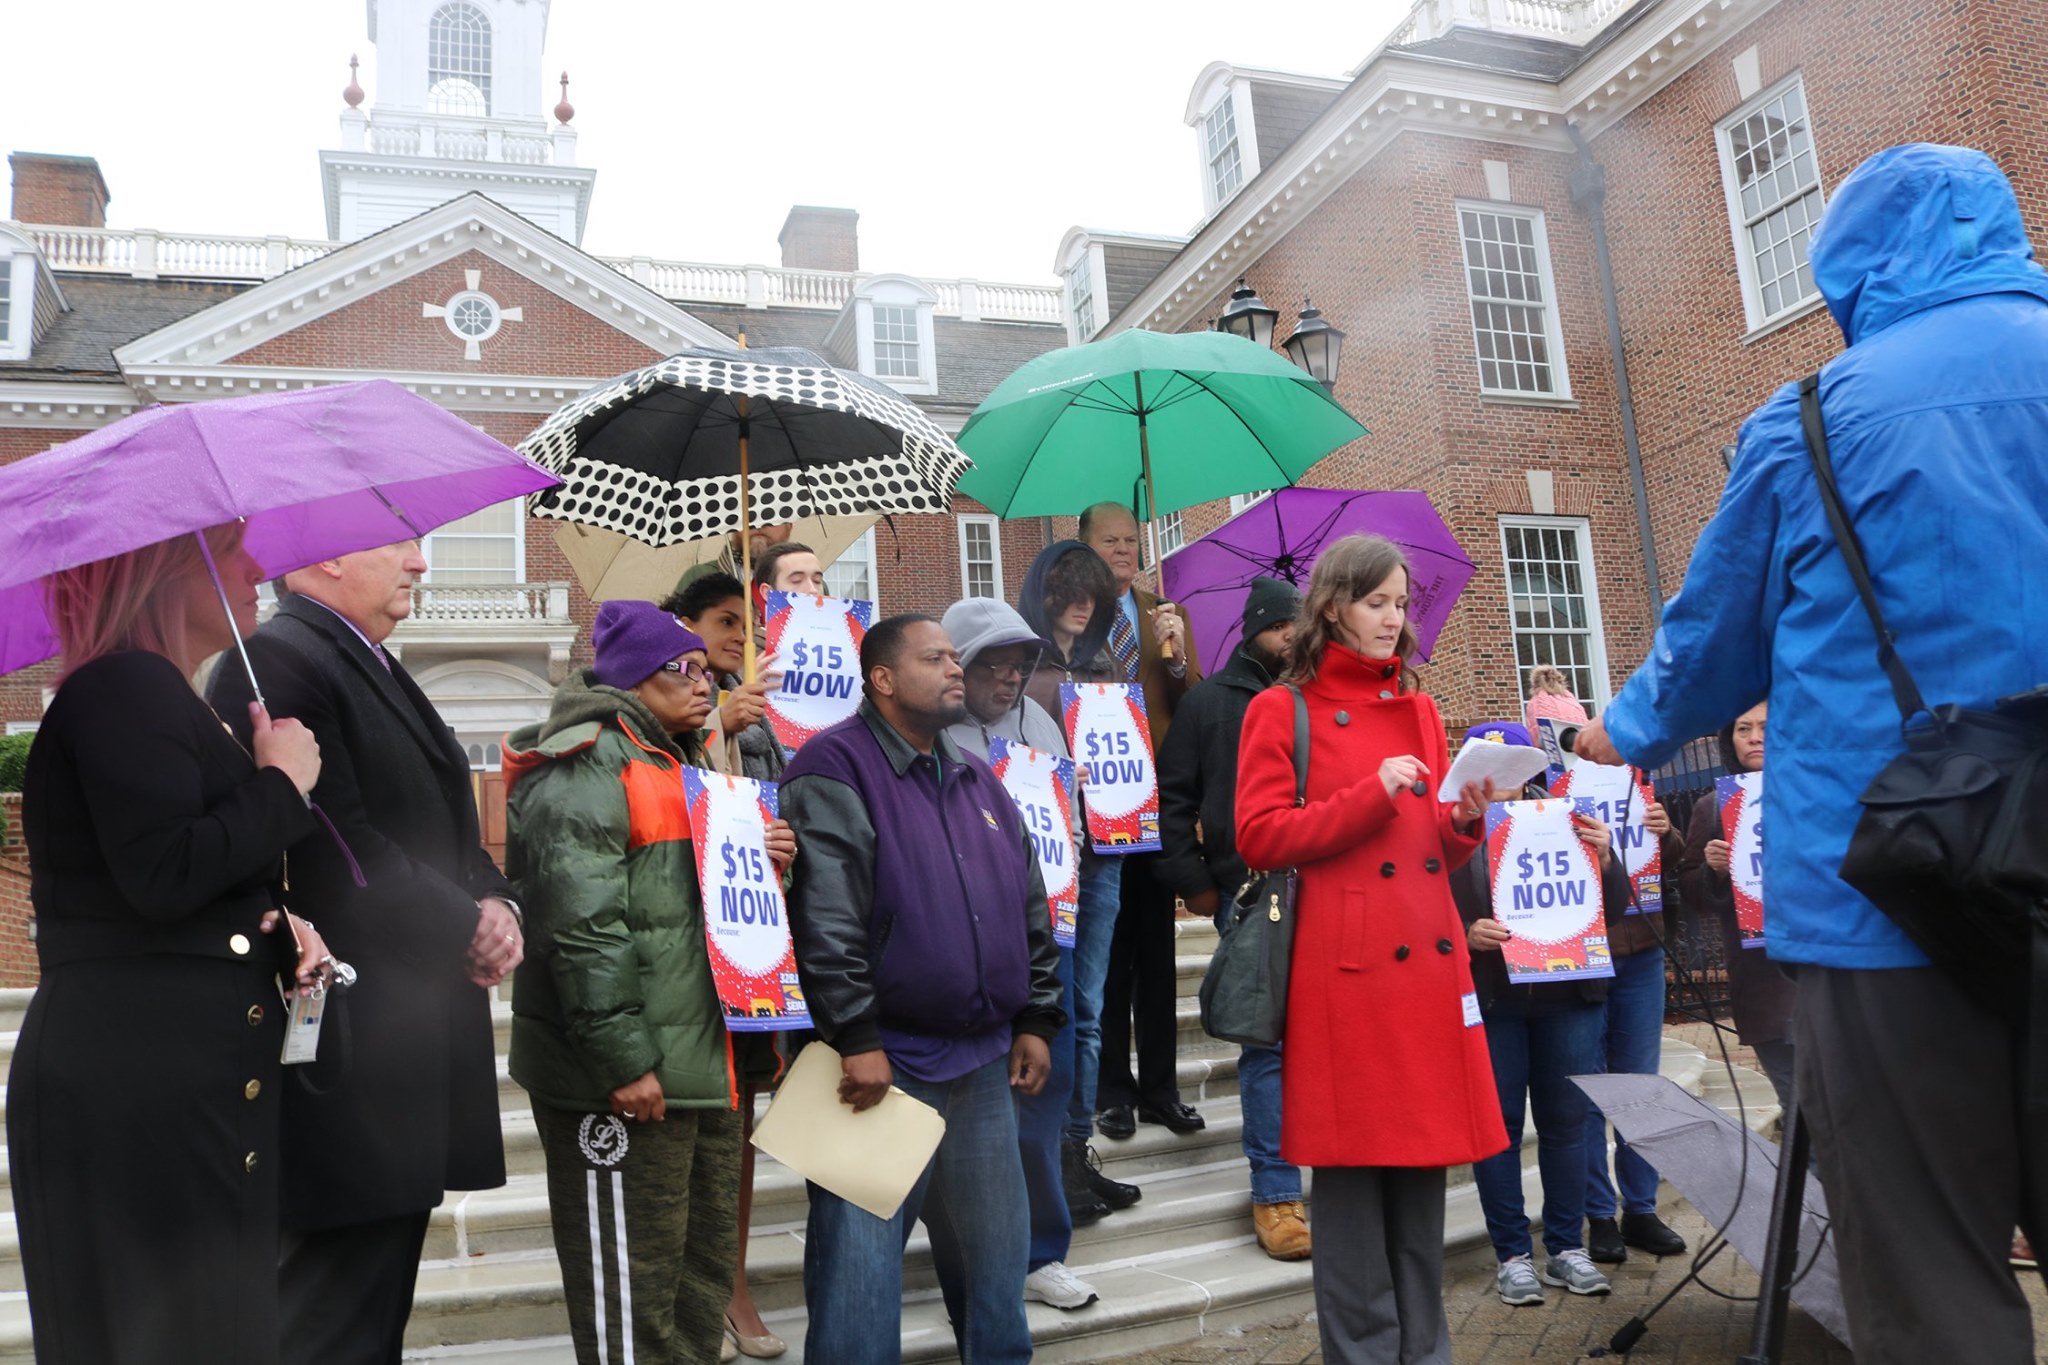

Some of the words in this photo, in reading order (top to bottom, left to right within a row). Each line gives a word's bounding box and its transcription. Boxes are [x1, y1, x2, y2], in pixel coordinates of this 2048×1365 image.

[792, 637, 843, 670] $15
[781, 669, 855, 699] NOW
[1085, 727, 1130, 760] $15
[1083, 759, 1143, 785] NOW
[1138, 812, 1159, 820] 32BJ
[1597, 798, 1630, 823] 15
[721, 836, 764, 884] $15
[1516, 847, 1570, 883] $15
[1638, 875, 1661, 884] 32BJ
[1512, 879, 1586, 910] NOW
[1640, 893, 1661, 902] SEIU
[720, 885, 779, 927] NOW
[1056, 900, 1077, 912] 32BJ
[1056, 922, 1075, 933] SEIU
[1583, 936, 1607, 946] 32BJ
[1588, 956, 1611, 965] SEIU
[779, 972, 799, 984] 32BJ
[785, 1001, 806, 1011] SEIU
